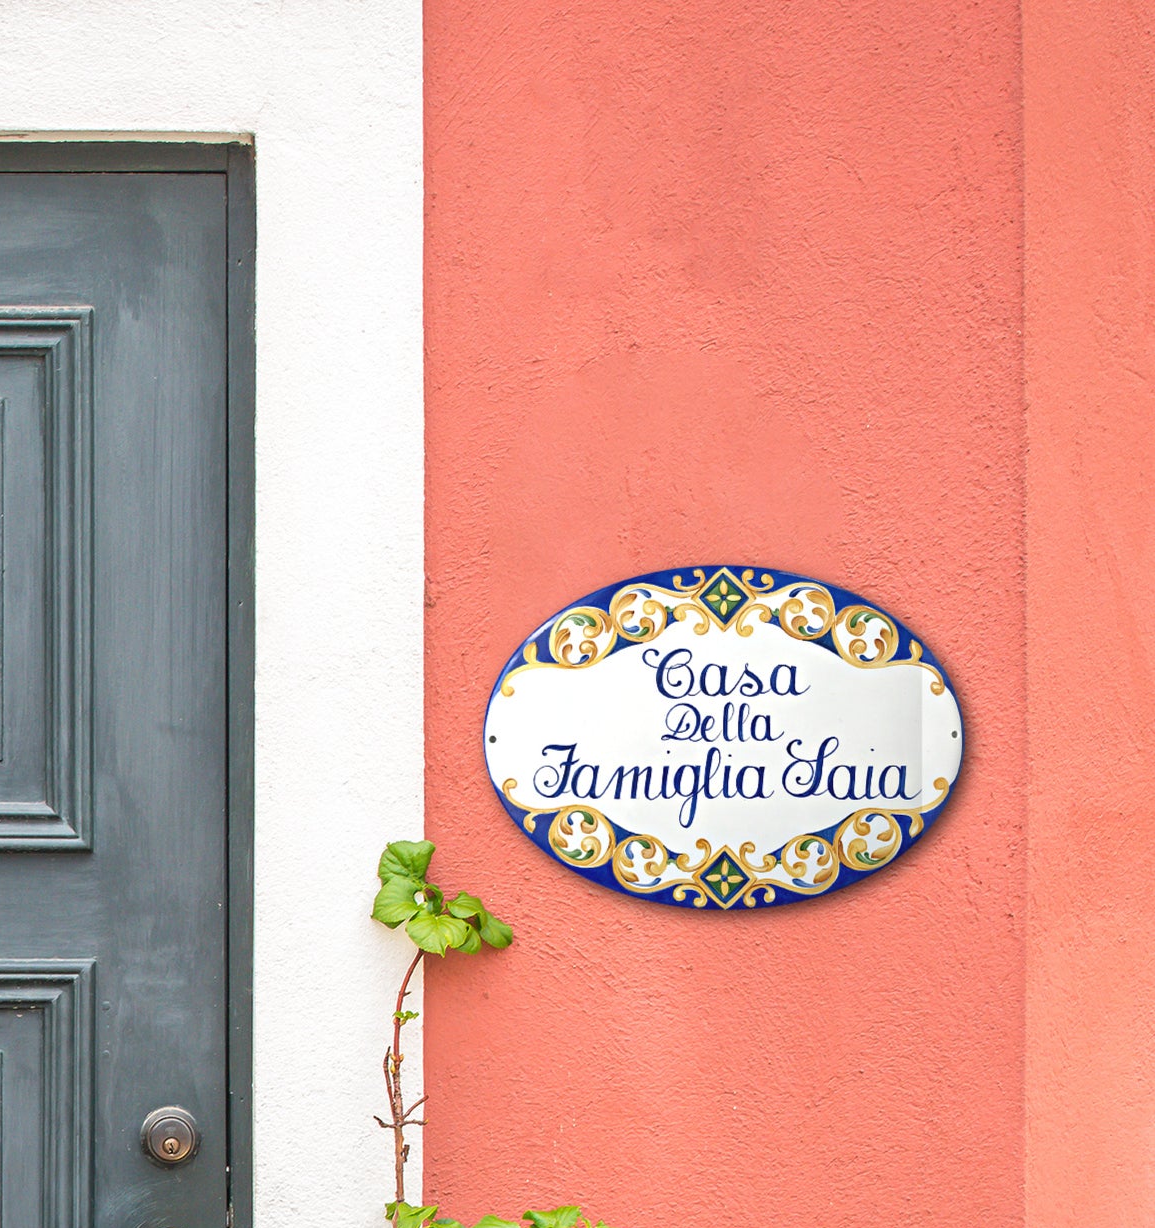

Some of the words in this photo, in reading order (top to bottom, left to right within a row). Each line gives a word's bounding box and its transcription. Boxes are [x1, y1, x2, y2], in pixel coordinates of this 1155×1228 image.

[642, 648, 811, 699] Casa
[660, 702, 785, 743] Della
[532, 742, 775, 829] Famiglia
[781, 736, 922, 801] Saia
